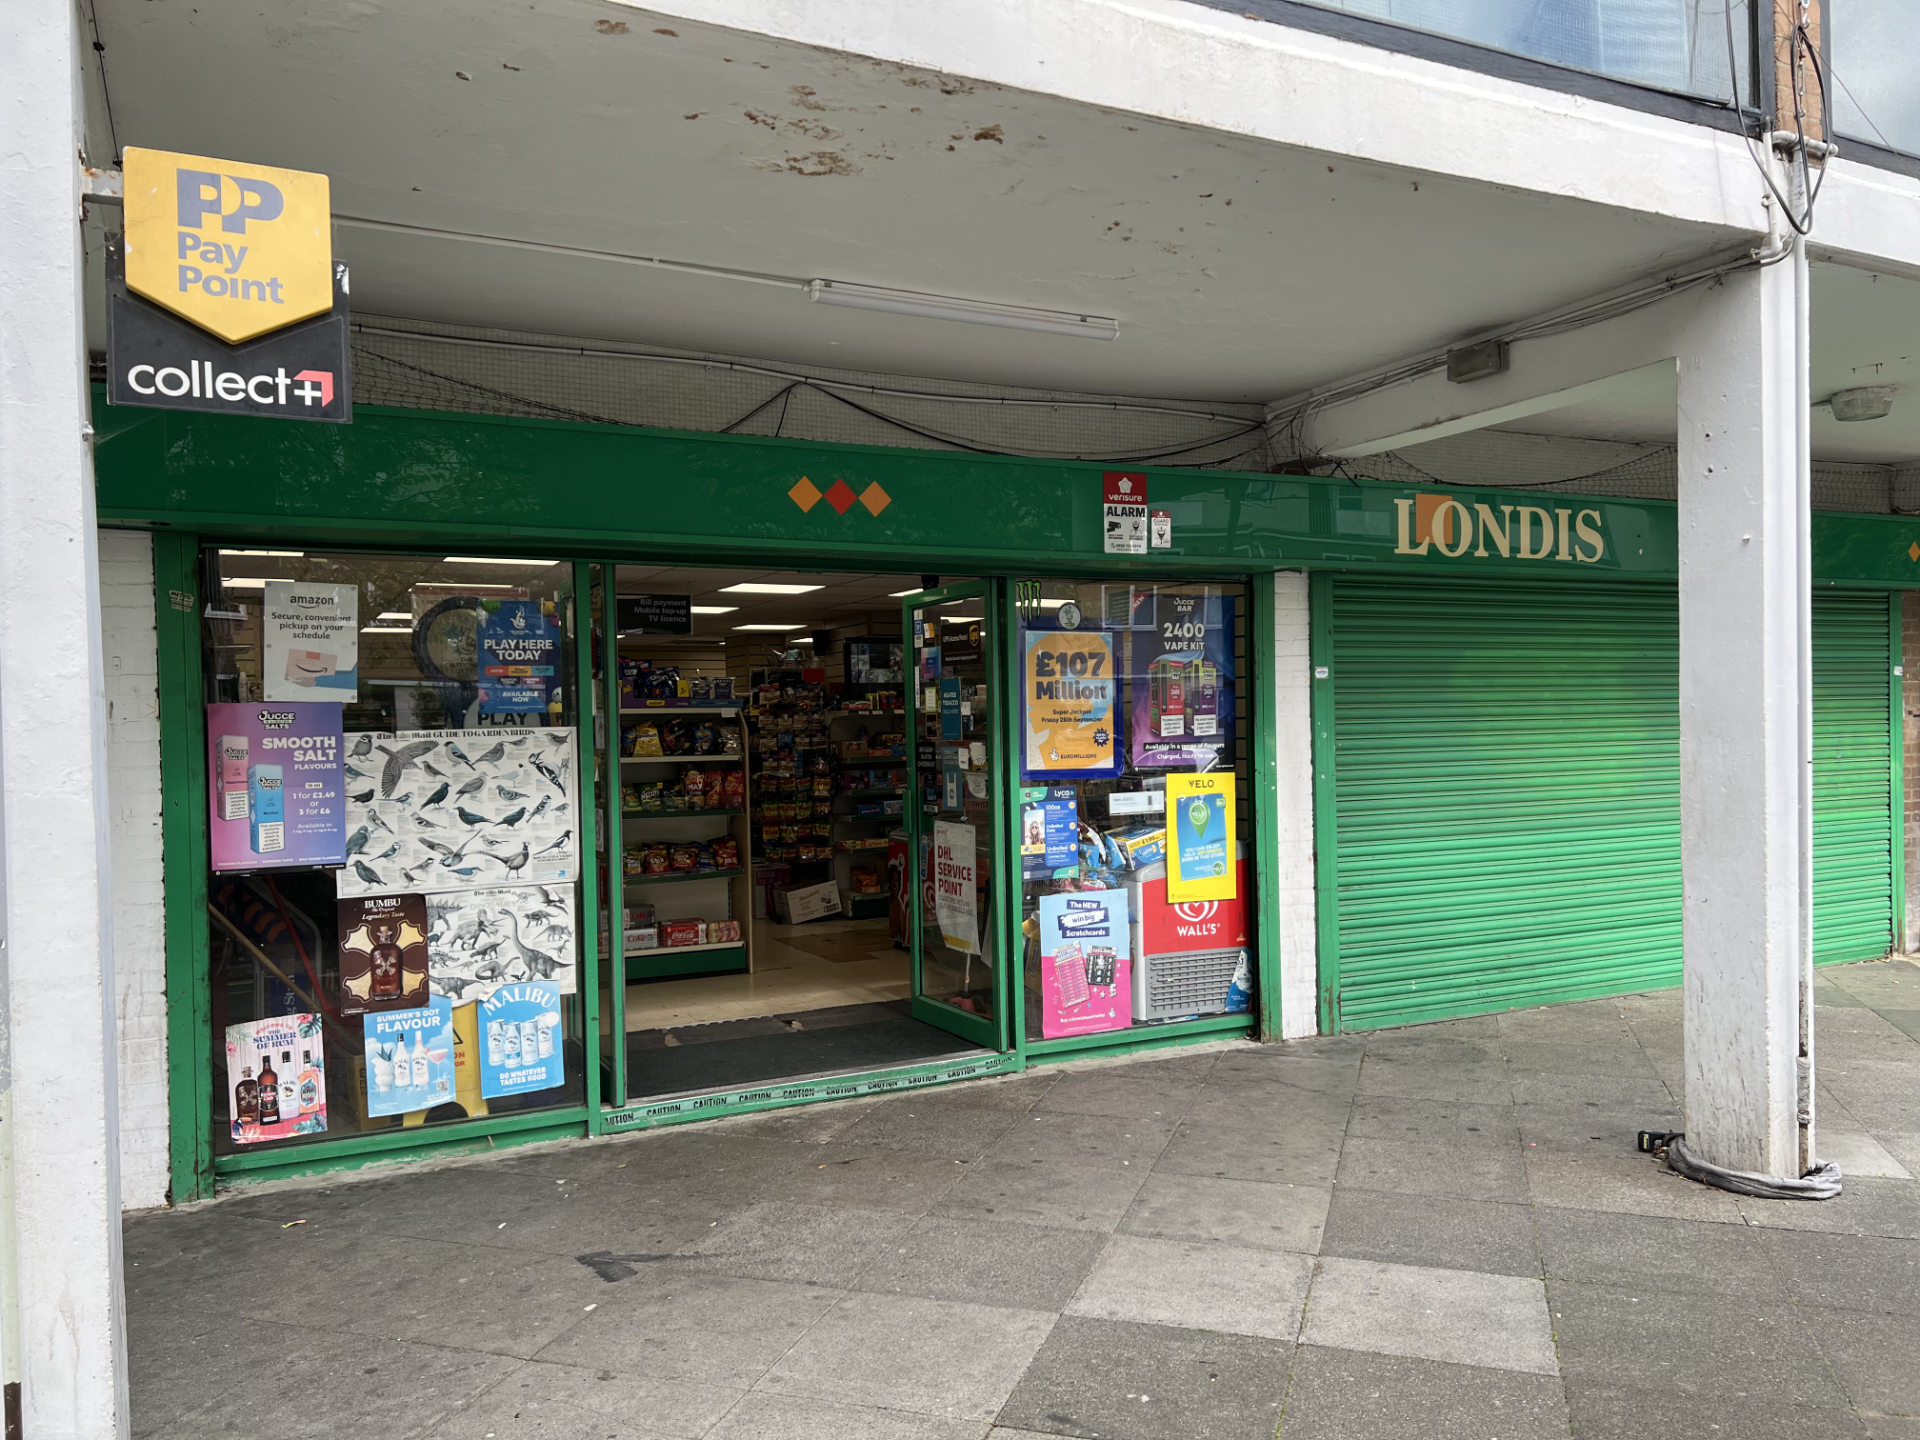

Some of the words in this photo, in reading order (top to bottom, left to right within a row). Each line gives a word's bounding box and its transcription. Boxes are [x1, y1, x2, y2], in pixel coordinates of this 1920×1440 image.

[177, 231, 248, 274] Pay
[178, 264, 284, 304] Point
[1108, 494, 1142, 502] verisure
[1107, 506, 1145, 518] ALARM
[1394, 498, 1604, 563] LONDIS
[290, 595, 334, 605] amazon
[640, 598, 652, 606] Bill
[654, 600, 687, 608] payment
[1133, 594, 1146, 609] NEW
[1174, 597, 1195, 606] JUCCE
[661, 607, 687, 615] top-up
[271, 612, 304, 622] Secure,
[660, 615, 687, 623] licence
[279, 622, 308, 631] pickup
[1163, 622, 1206, 638] 2400
[293, 631, 331, 640] schedule
[484, 639, 519, 650] PLAY
[519, 639, 553, 650] HERE
[1164, 641, 1188, 651] VAPE
[1190, 641, 1205, 651] KIT
[496, 650, 541, 661] TODAY
[1036, 651, 1106, 677] £107
[1036, 680, 1108, 700] Million
[258, 710, 296, 720] JUCCE
[1069, 708, 1092, 716] Jackpot
[477, 712, 529, 726] PLAY
[1041, 716, 1059, 724] Friday
[1073, 716, 1103, 724] September
[463, 730, 474, 738] TO
[262, 735, 336, 749] SMOOTH
[293, 749, 337, 761] SALT
[1060, 752, 1097, 760] EUROMILLIONS
[1156, 752, 1181, 761] Charged,
[1182, 752, 1198, 760] ready
[294, 762, 337, 771] FLAVOURS
[1188, 779, 1215, 788] VELO
[312, 791, 336, 799] £2.49
[1054, 789, 1070, 798] Lyca
[305, 807, 318, 815] for
[937, 845, 954, 862] DHL
[937, 861, 972, 882] SERVICE
[938, 878, 963, 897] POINT
[364, 897, 401, 909] BUMBU
[470, 901, 516, 910] DINOSAURS
[1070, 901, 1082, 909] The
[1082, 901, 1098, 909] NEW
[361, 912, 390, 921] Legendary
[631, 911, 647, 921] Coke
[1072, 915, 1084, 924] win
[1084, 913, 1095, 923] big
[1066, 928, 1106, 937] Scratchcards
[1177, 923, 1217, 937] WALL'S
[627, 934, 647, 943] Coke
[483, 986, 556, 1016] MALIBU
[376, 1009, 421, 1023] SUMMER'S
[422, 1008, 440, 1017] GOT
[255, 1023, 284, 1035] WELCOME
[377, 1016, 441, 1034] FLAVOUR
[253, 1032, 297, 1044] SUMMER
[256, 1042, 271, 1050] OF
[272, 1039, 294, 1048] RUM
[511, 1067, 547, 1078] WHATEVER
[500, 1076, 526, 1086] TASTES
[527, 1073, 547, 1082] GOOD
[908, 1074, 938, 1085] CAUTION
[826, 1086, 857, 1096] CAUTION
[738, 1092, 772, 1102] CAUTION
[693, 1097, 727, 1109] CAUTION
[647, 1104, 681, 1116] CAUTION
